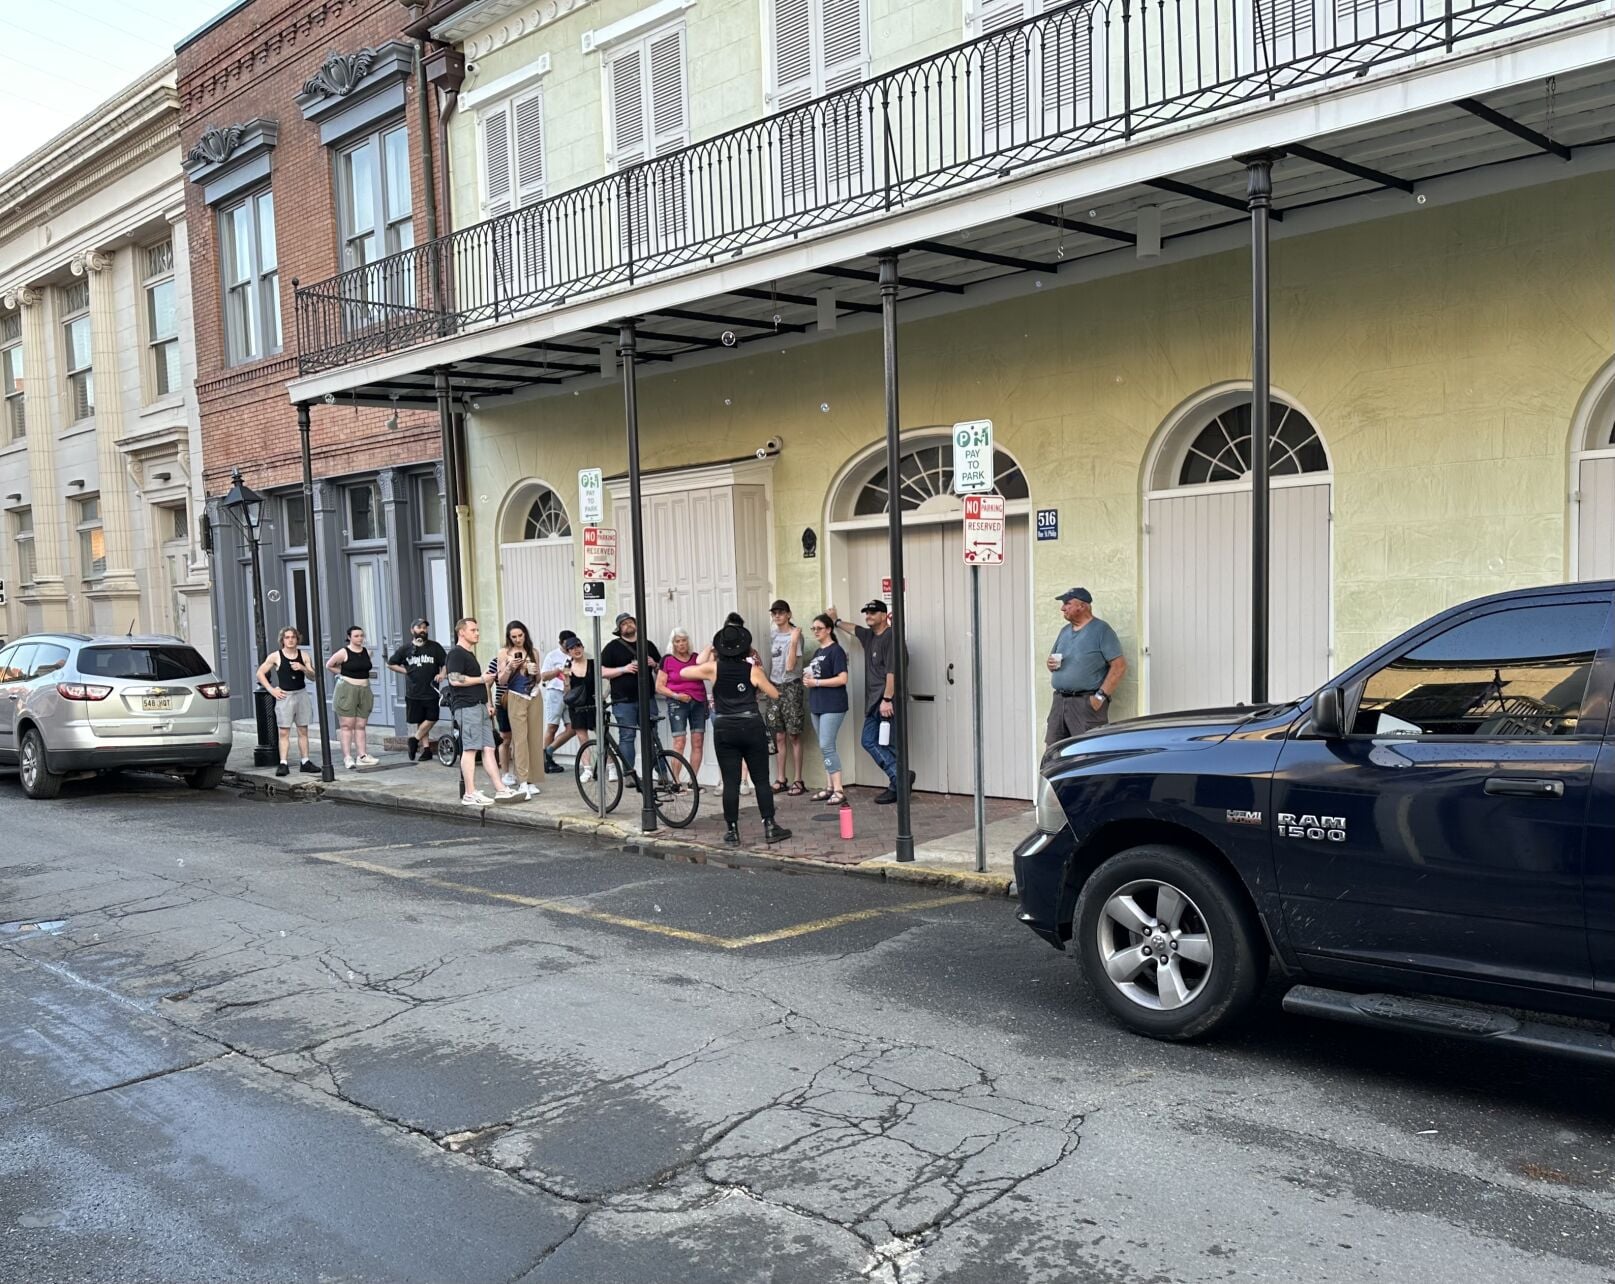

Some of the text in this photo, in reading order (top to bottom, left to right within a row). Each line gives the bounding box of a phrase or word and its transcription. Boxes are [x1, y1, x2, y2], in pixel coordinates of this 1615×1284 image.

[965, 449, 980, 459] PAY
[968, 460, 980, 469] TO
[962, 471, 985, 481] PARK
[966, 500, 1003, 514] NO PARKING
[1038, 511, 1056, 526] 516
[968, 522, 1002, 531] RESERVED
[585, 531, 596, 542] NO
[586, 547, 615, 555] RESERVED
[1226, 809, 1262, 819] HEMI
[1278, 812, 1346, 829] RAM
[1278, 825, 1346, 842] 1500
